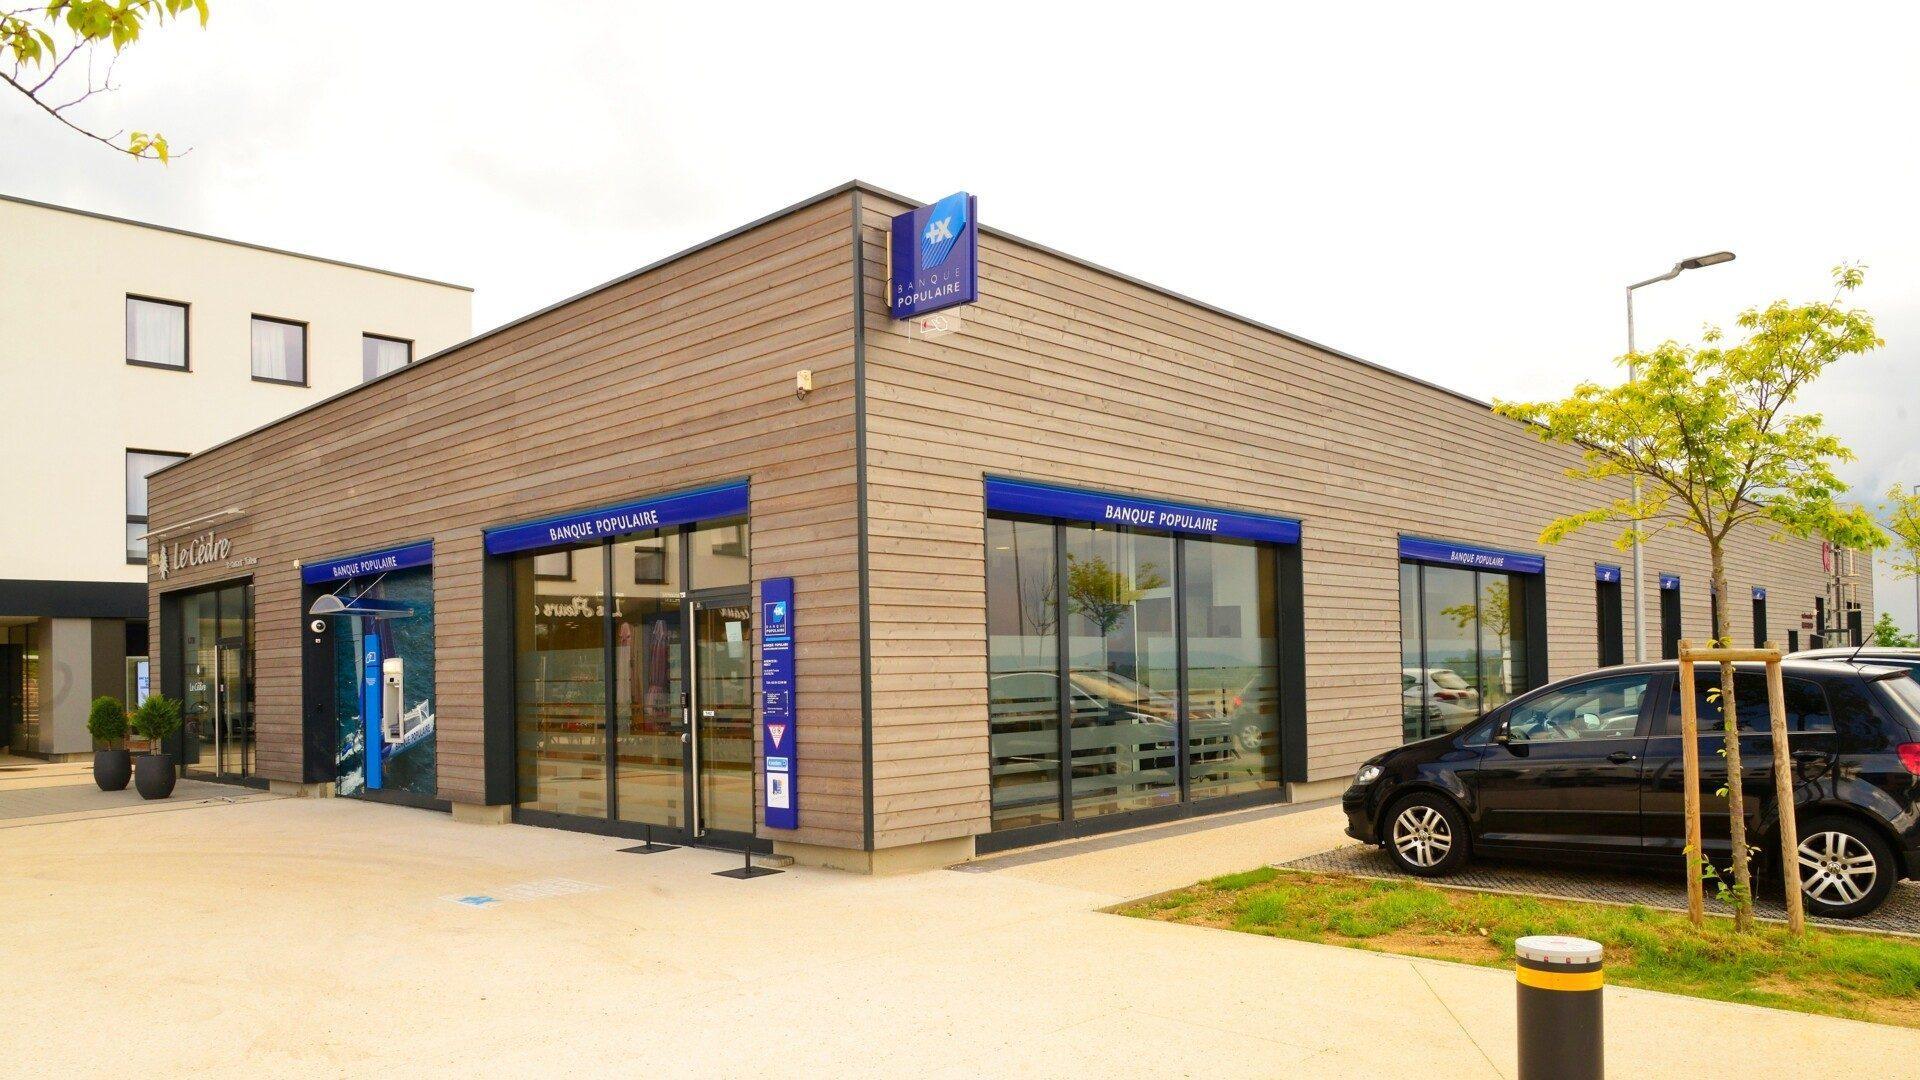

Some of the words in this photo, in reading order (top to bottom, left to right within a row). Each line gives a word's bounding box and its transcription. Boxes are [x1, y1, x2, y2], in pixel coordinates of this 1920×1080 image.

[898, 267, 960, 293] BANQUE
[898, 282, 960, 308] POPULAIRE
[549, 521, 593, 541] BANQUE
[596, 510, 659, 534] POPULAIRE
[1105, 505, 1155, 524] BANQUE
[1159, 512, 1219, 531] POPULAIRE
[333, 563, 360, 577] BANQUE
[361, 556, 397, 572] POPULAIRE
[1450, 551, 1475, 564] BANQUE
[1475, 554, 1504, 567] POPULAIRE
